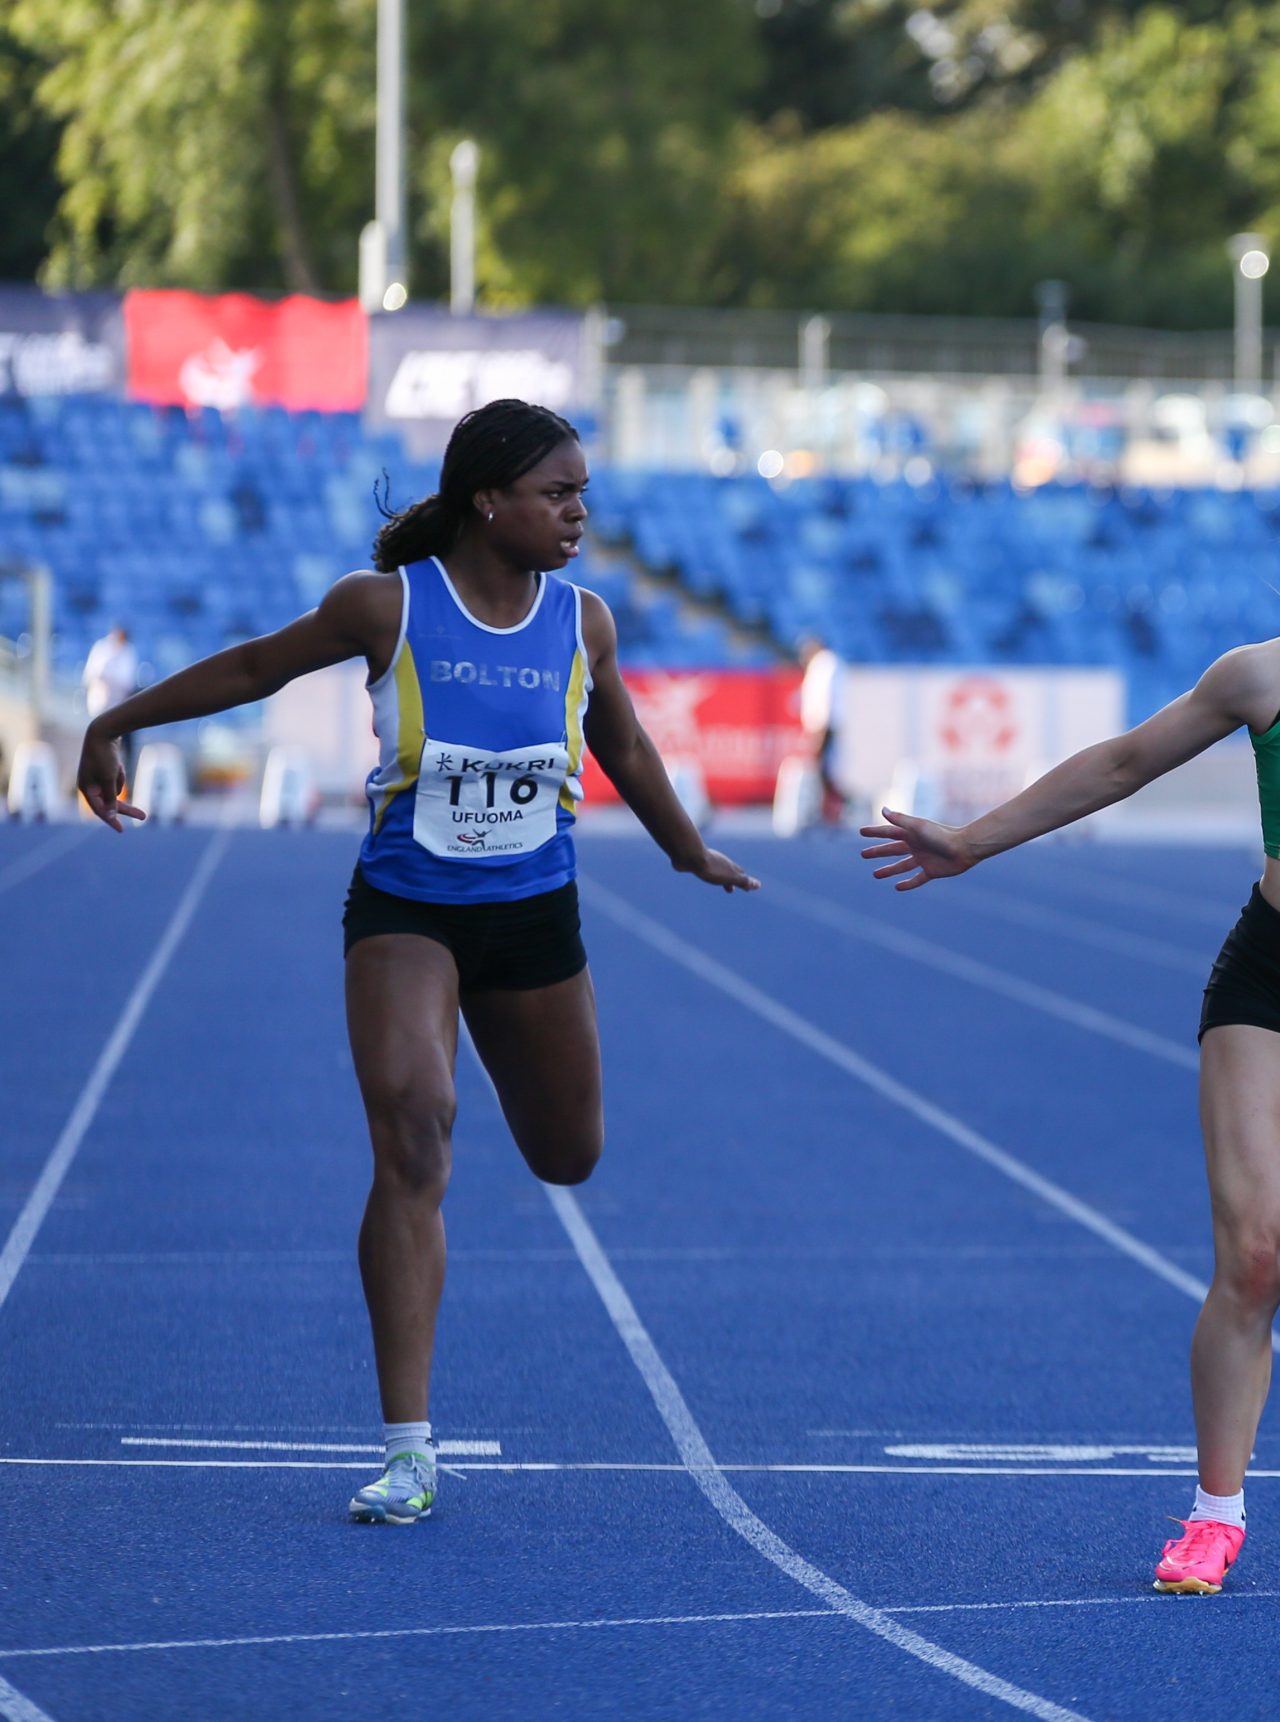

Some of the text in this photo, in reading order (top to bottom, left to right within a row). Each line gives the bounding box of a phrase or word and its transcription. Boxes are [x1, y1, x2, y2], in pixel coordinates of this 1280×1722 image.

[430, 660, 560, 692] BOLTON
[461, 757, 555, 773] KUKRI
[446, 770, 539, 809] 116
[451, 810, 524, 824] UFUOMA
[447, 842, 523, 853] ENGLAND ATHLETICS
